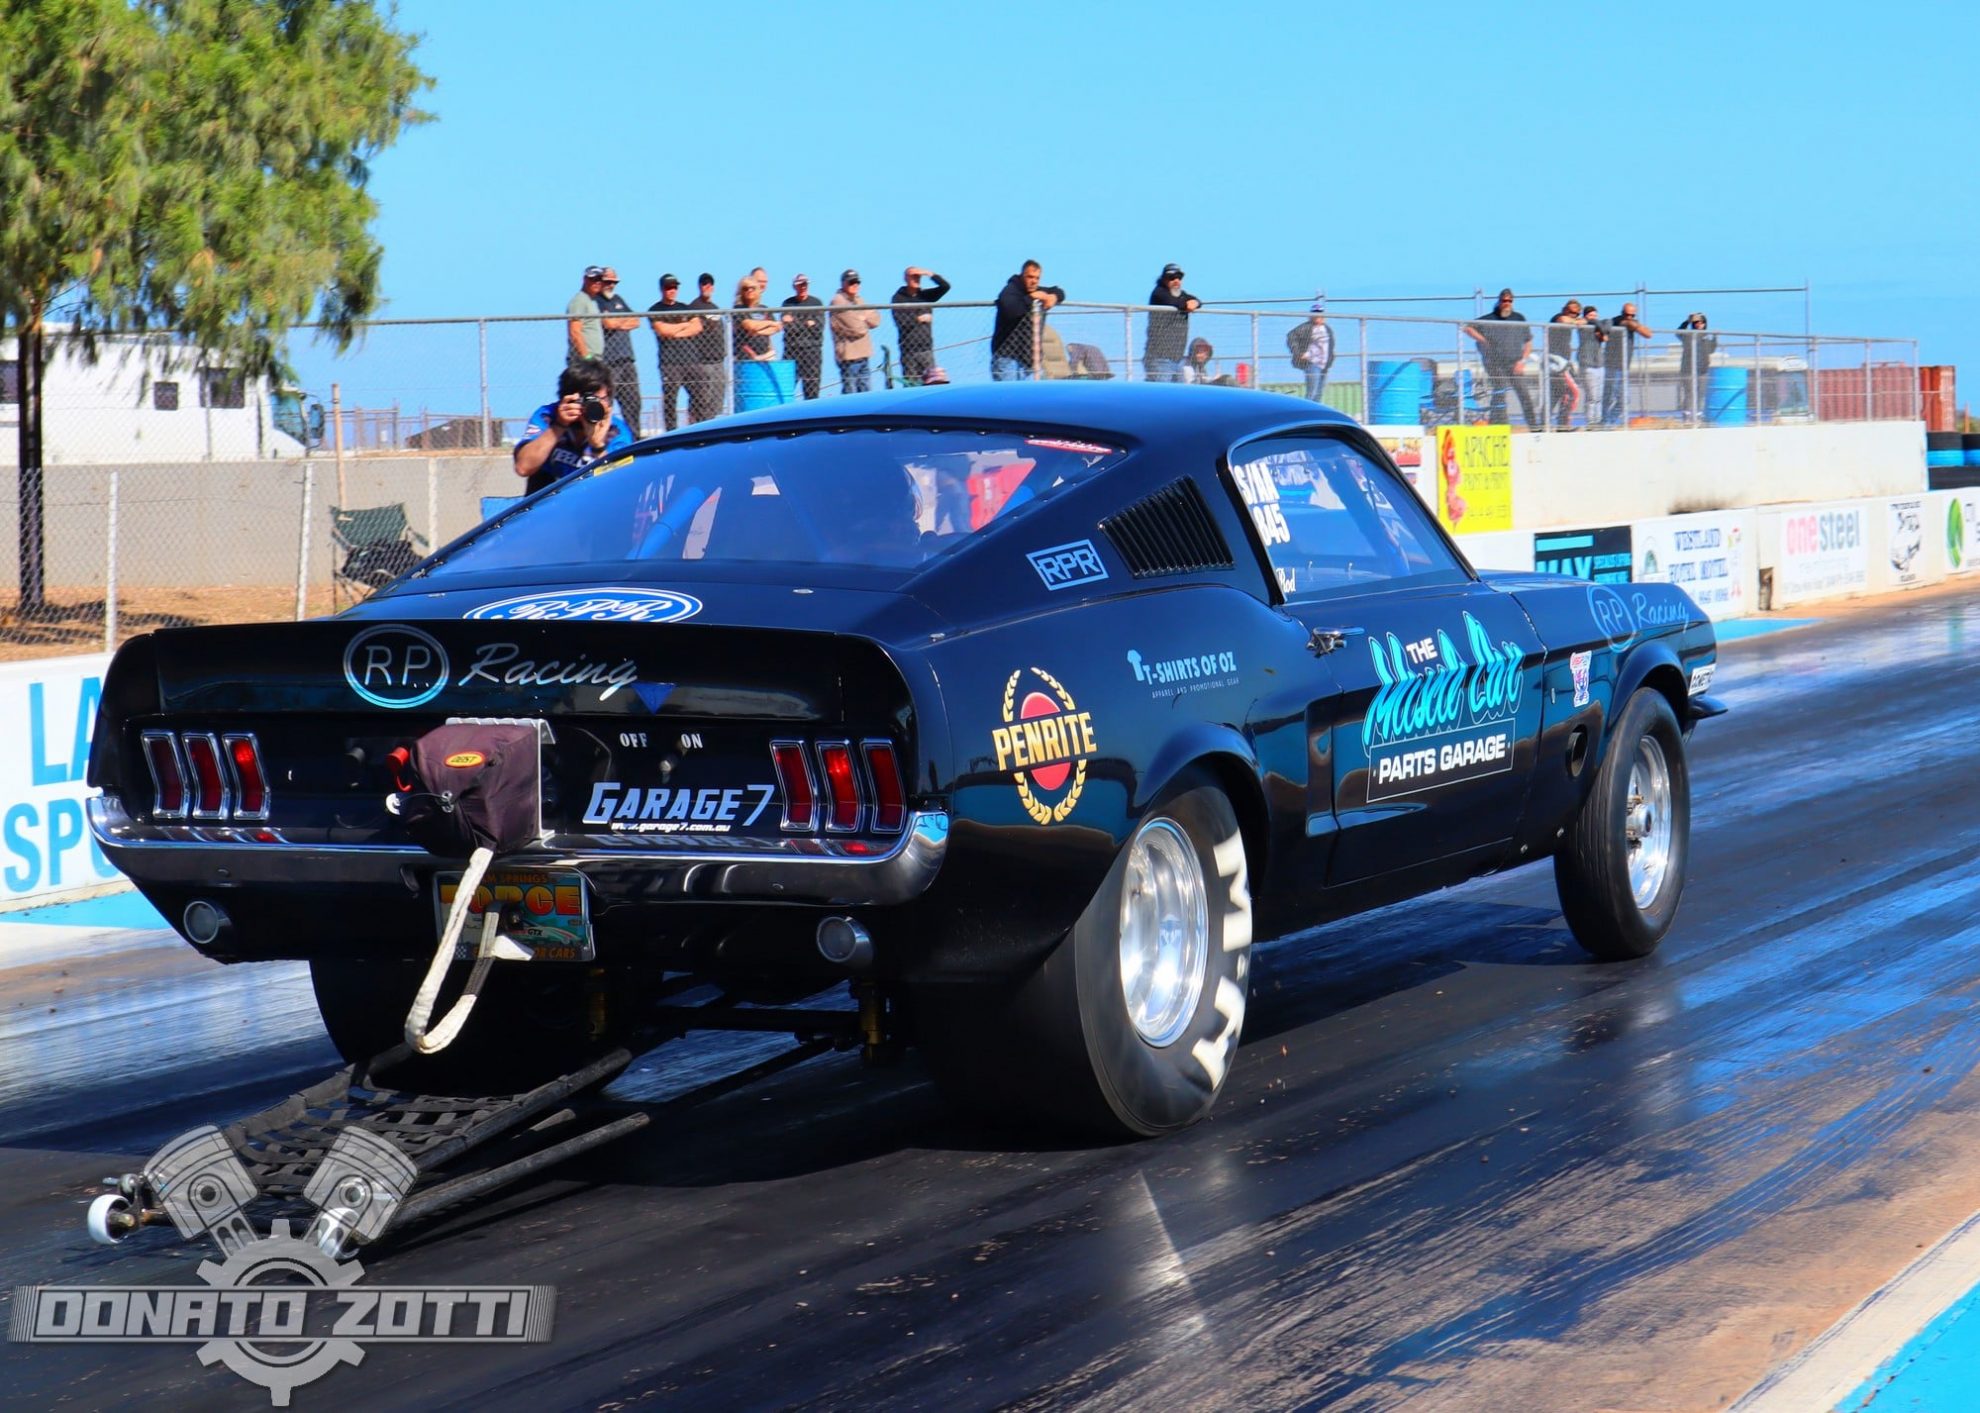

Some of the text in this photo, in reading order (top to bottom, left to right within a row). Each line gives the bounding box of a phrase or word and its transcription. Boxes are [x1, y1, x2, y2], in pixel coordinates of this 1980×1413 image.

[1787, 510, 1861, 556] onesteel
[1037, 548, 1098, 584] RPR
[1632, 592, 1690, 634] Racing
[1201, 654, 1217, 676] OF
[1219, 651, 1237, 673] OZ
[1405, 637, 1438, 664] THE
[1463, 611, 1526, 714] Car
[458, 643, 639, 701] Racing
[620, 732, 648, 748] OFF
[680, 733, 704, 749] ON
[992, 712, 1097, 771] PENRITE
[1378, 733, 1507, 785] PARTS GARAGE
